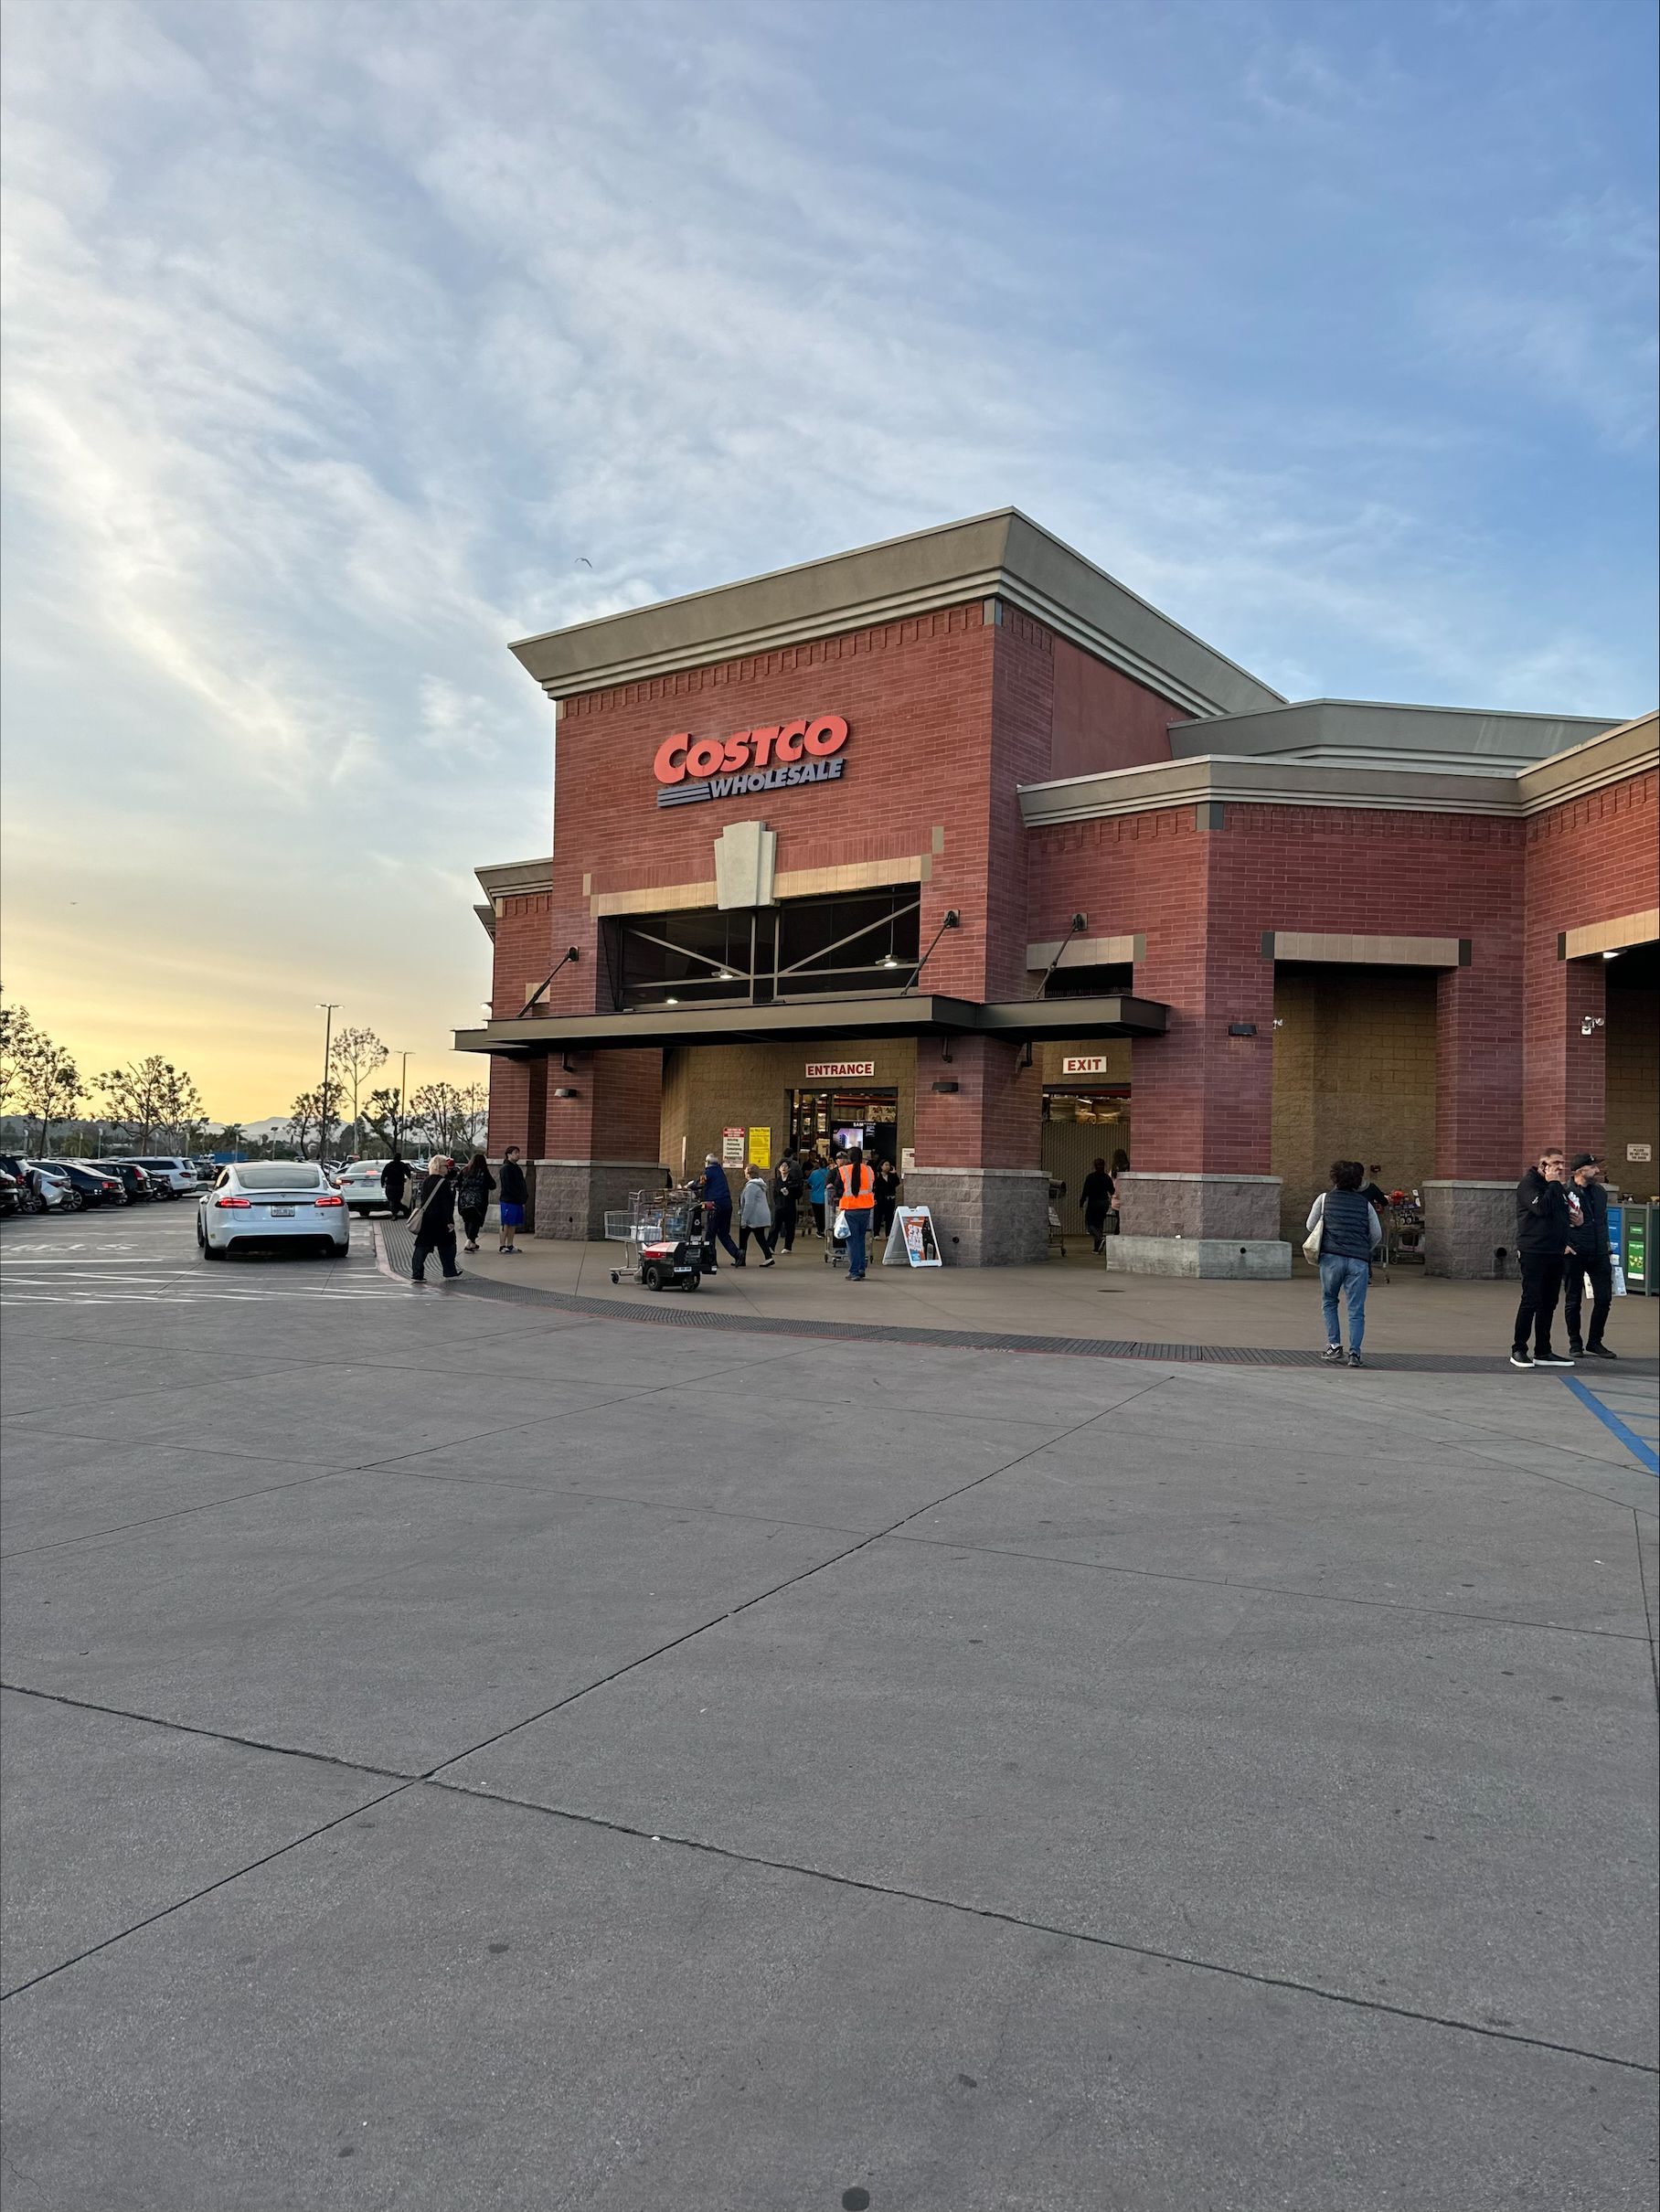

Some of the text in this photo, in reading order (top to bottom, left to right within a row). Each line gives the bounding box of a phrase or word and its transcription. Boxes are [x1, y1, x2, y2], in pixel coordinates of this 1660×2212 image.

[654, 715, 848, 784] COSTCO
[709, 759, 846, 799] WHOLESALE
[807, 1063, 872, 1076] ENTRANCE
[1068, 1058, 1101, 1071] EXIT
